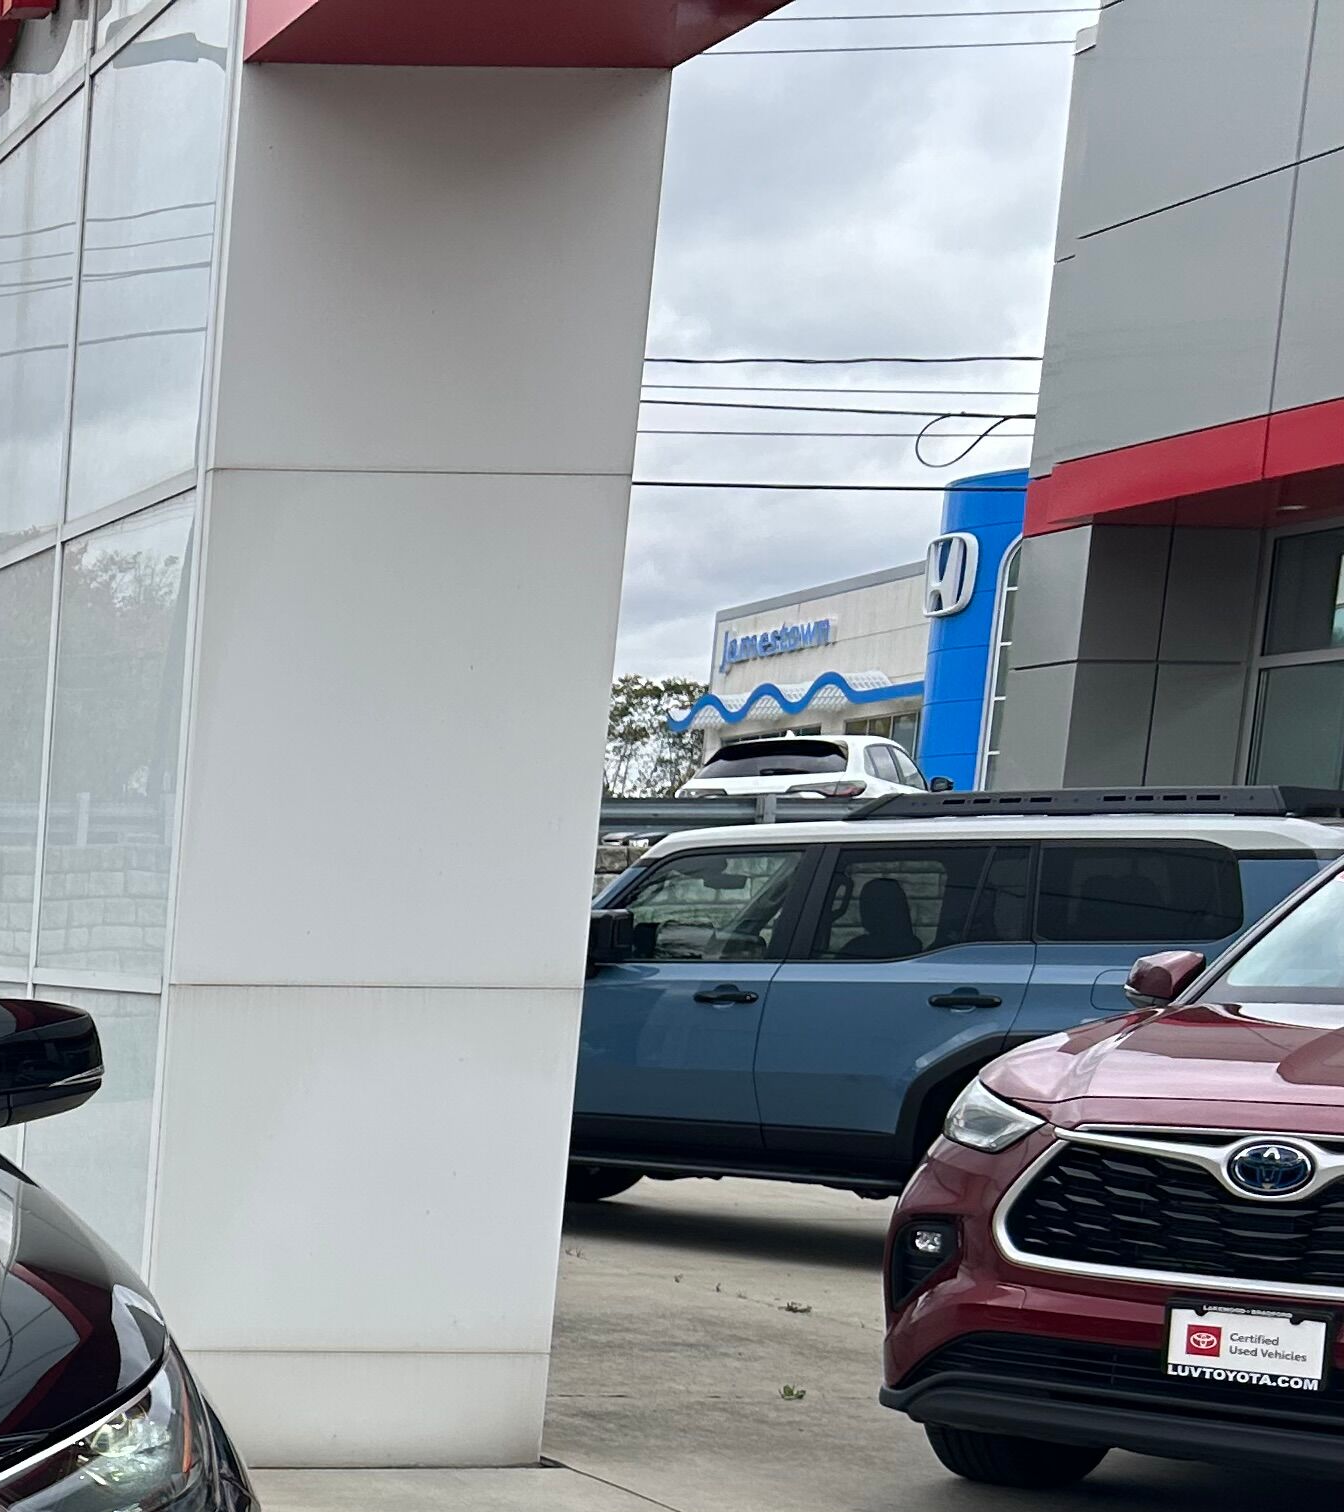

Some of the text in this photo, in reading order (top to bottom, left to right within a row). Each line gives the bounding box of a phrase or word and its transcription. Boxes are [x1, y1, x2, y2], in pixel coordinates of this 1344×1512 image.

[719, 618, 833, 673] Jamestown
[1229, 1332, 1280, 1346] Certified
[1229, 1345, 1307, 1362] Used Vehicles
[1167, 1364, 1319, 1391] LUVTOYOTA.COM
